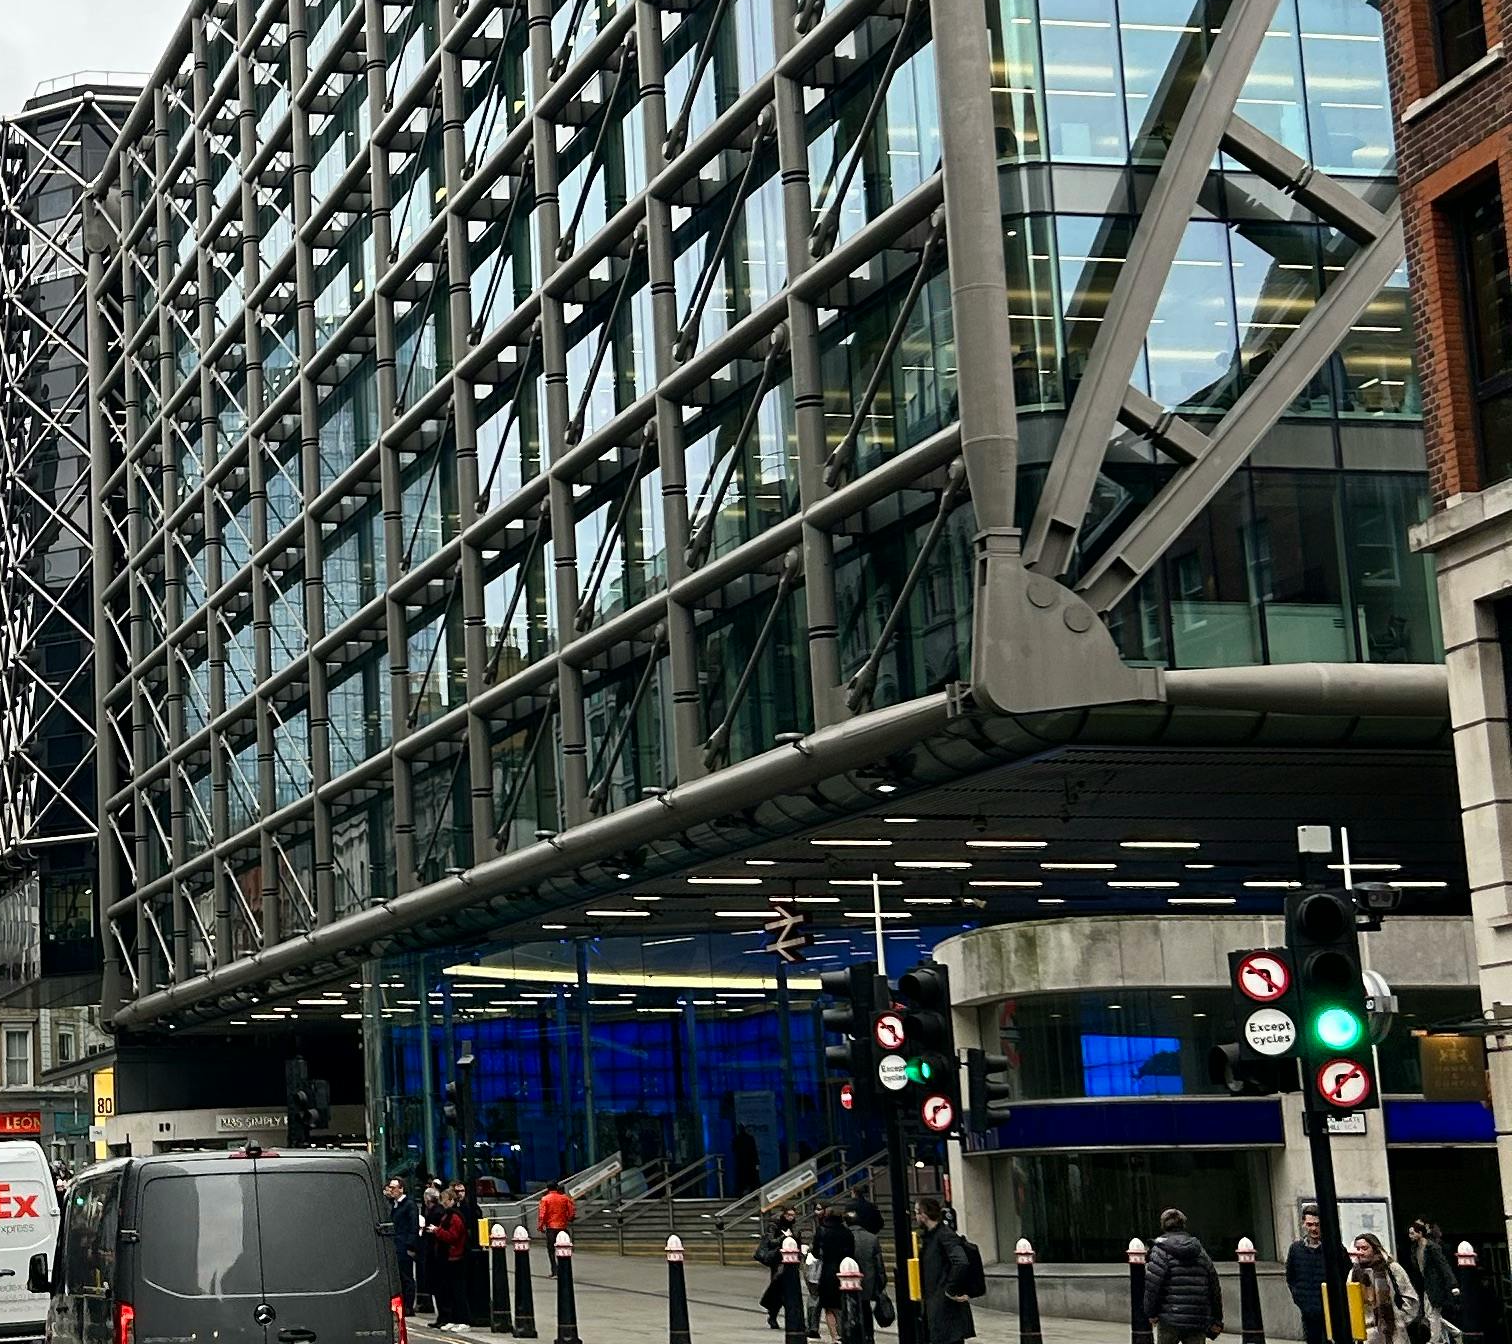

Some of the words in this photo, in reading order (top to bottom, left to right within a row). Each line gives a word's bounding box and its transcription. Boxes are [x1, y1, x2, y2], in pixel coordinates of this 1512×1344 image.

[1249, 1021, 1291, 1032] Except
[1253, 1034, 1291, 1046] cycles
[97, 1097, 113, 1114] 80
